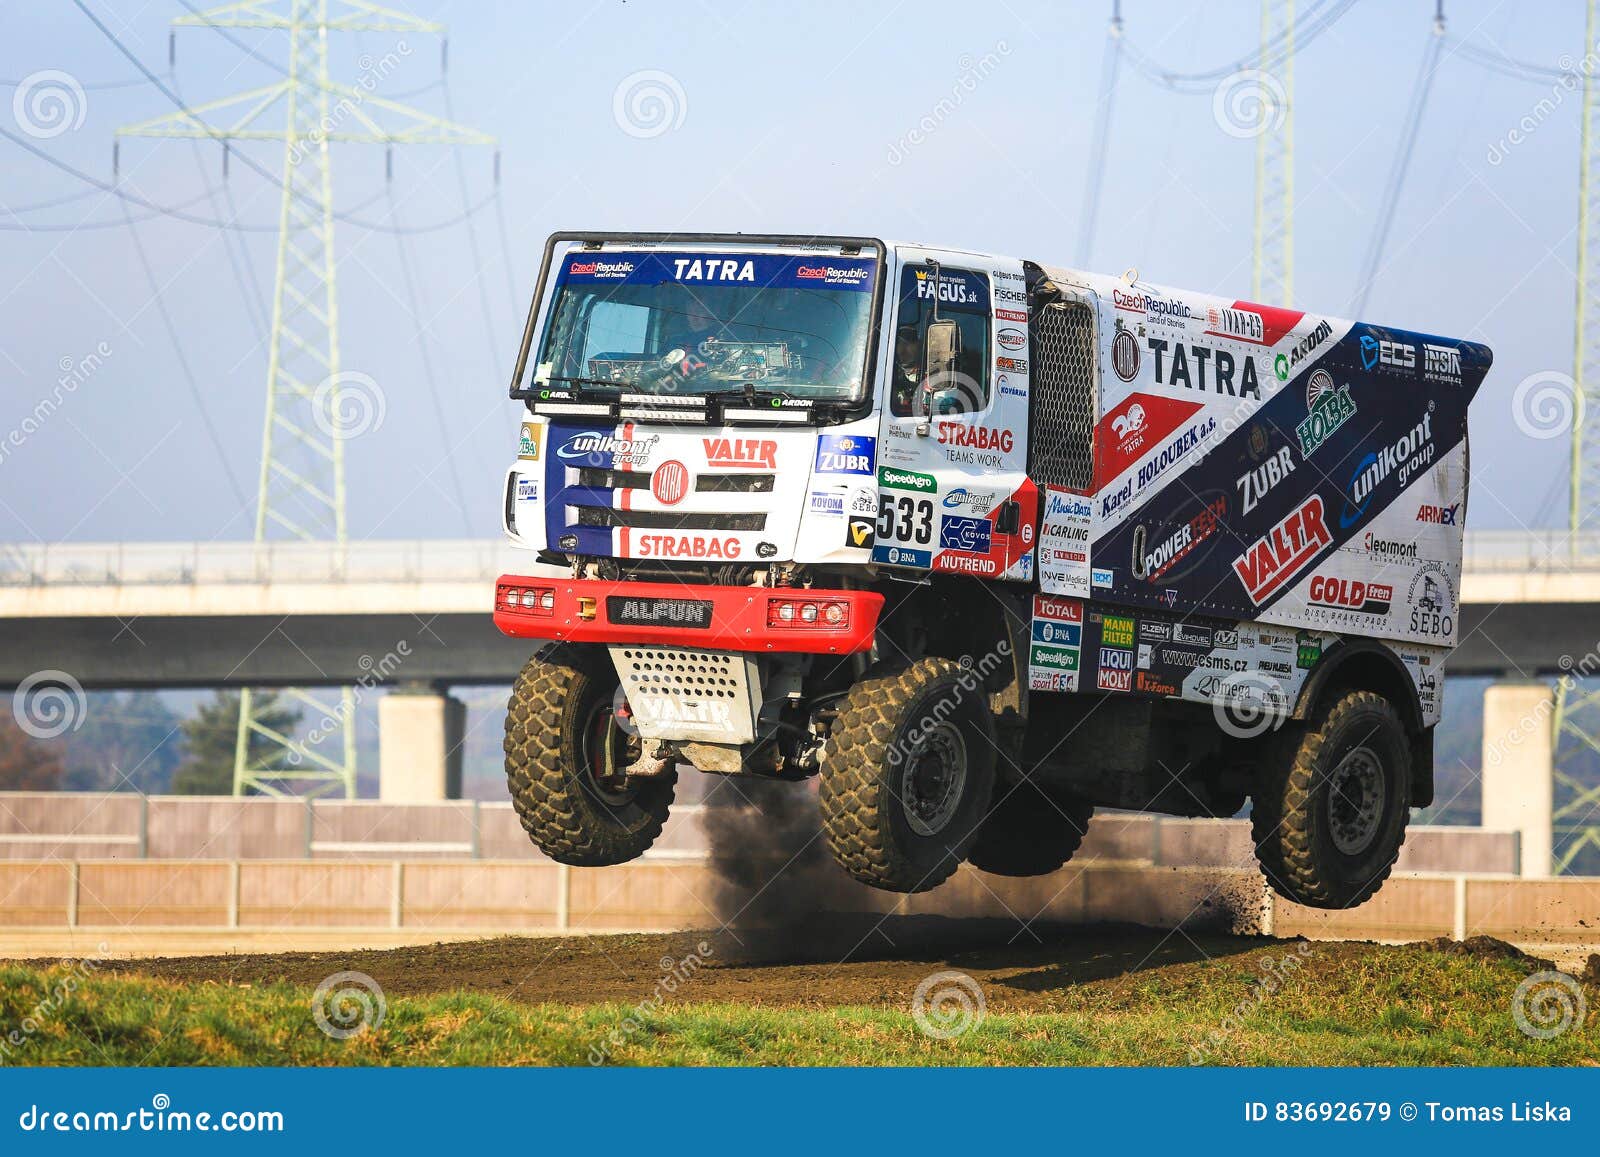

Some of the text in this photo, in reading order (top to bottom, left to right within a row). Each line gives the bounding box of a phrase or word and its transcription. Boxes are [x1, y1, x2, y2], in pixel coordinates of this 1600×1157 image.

[673, 259, 755, 282] TATRA
[1113, 289, 1192, 319] CzechRepublic
[1147, 313, 1160, 324] Land
[1166, 316, 1185, 329] Stories
[1289, 320, 1333, 368] ARDON
[1379, 340, 1416, 368] ECS
[1148, 337, 1262, 401] TATRA
[1295, 385, 1358, 461] HOLBA
[572, 434, 652, 455] unikont
[937, 421, 1014, 453] STRABAG
[1123, 435, 1145, 455] TATRA
[610, 451, 650, 466] group
[703, 438, 777, 469] VALTR
[820, 451, 871, 472] ZUBR
[946, 449, 974, 465] TEAMS
[1353, 410, 1432, 504] unikont
[1101, 477, 1133, 518] Karel
[1137, 424, 1199, 490] HOLOUBEK
[1200, 416, 1217, 439] a.s.
[1398, 441, 1436, 488] group
[884, 470, 932, 489] SpeedAgro
[1236, 445, 1297, 517] ZUBR
[811, 496, 843, 510] KOVONA
[877, 493, 934, 545] 533
[1415, 502, 1461, 526] ARMEX
[965, 530, 990, 540] KOVOS
[1050, 524, 1089, 541] CARLING
[1145, 495, 1227, 577] POWERTECH
[639, 535, 741, 559] STRABAG
[1233, 496, 1333, 605] VALTR
[1364, 532, 1417, 557] Clearmont
[900, 552, 916, 564] BNA
[940, 555, 996, 573] NUTREND
[1041, 570, 1088, 585] INVE Medical
[1309, 575, 1391, 607] GOLD fren
[1039, 599, 1077, 619] TOTAL
[1304, 608, 1388, 627] DISC BRAKE PADS
[1103, 618, 1134, 633] MANN
[1410, 606, 1453, 636] ŠEBO
[1054, 628, 1070, 641] BNA
[1103, 630, 1133, 645] FILTER
[1035, 649, 1074, 667] SpeedAgro
[1101, 650, 1131, 669] LIQUI
[1162, 649, 1249, 673] www.csms.cz
[1032, 679, 1051, 689] sport
[1099, 669, 1131, 689] MOLY
